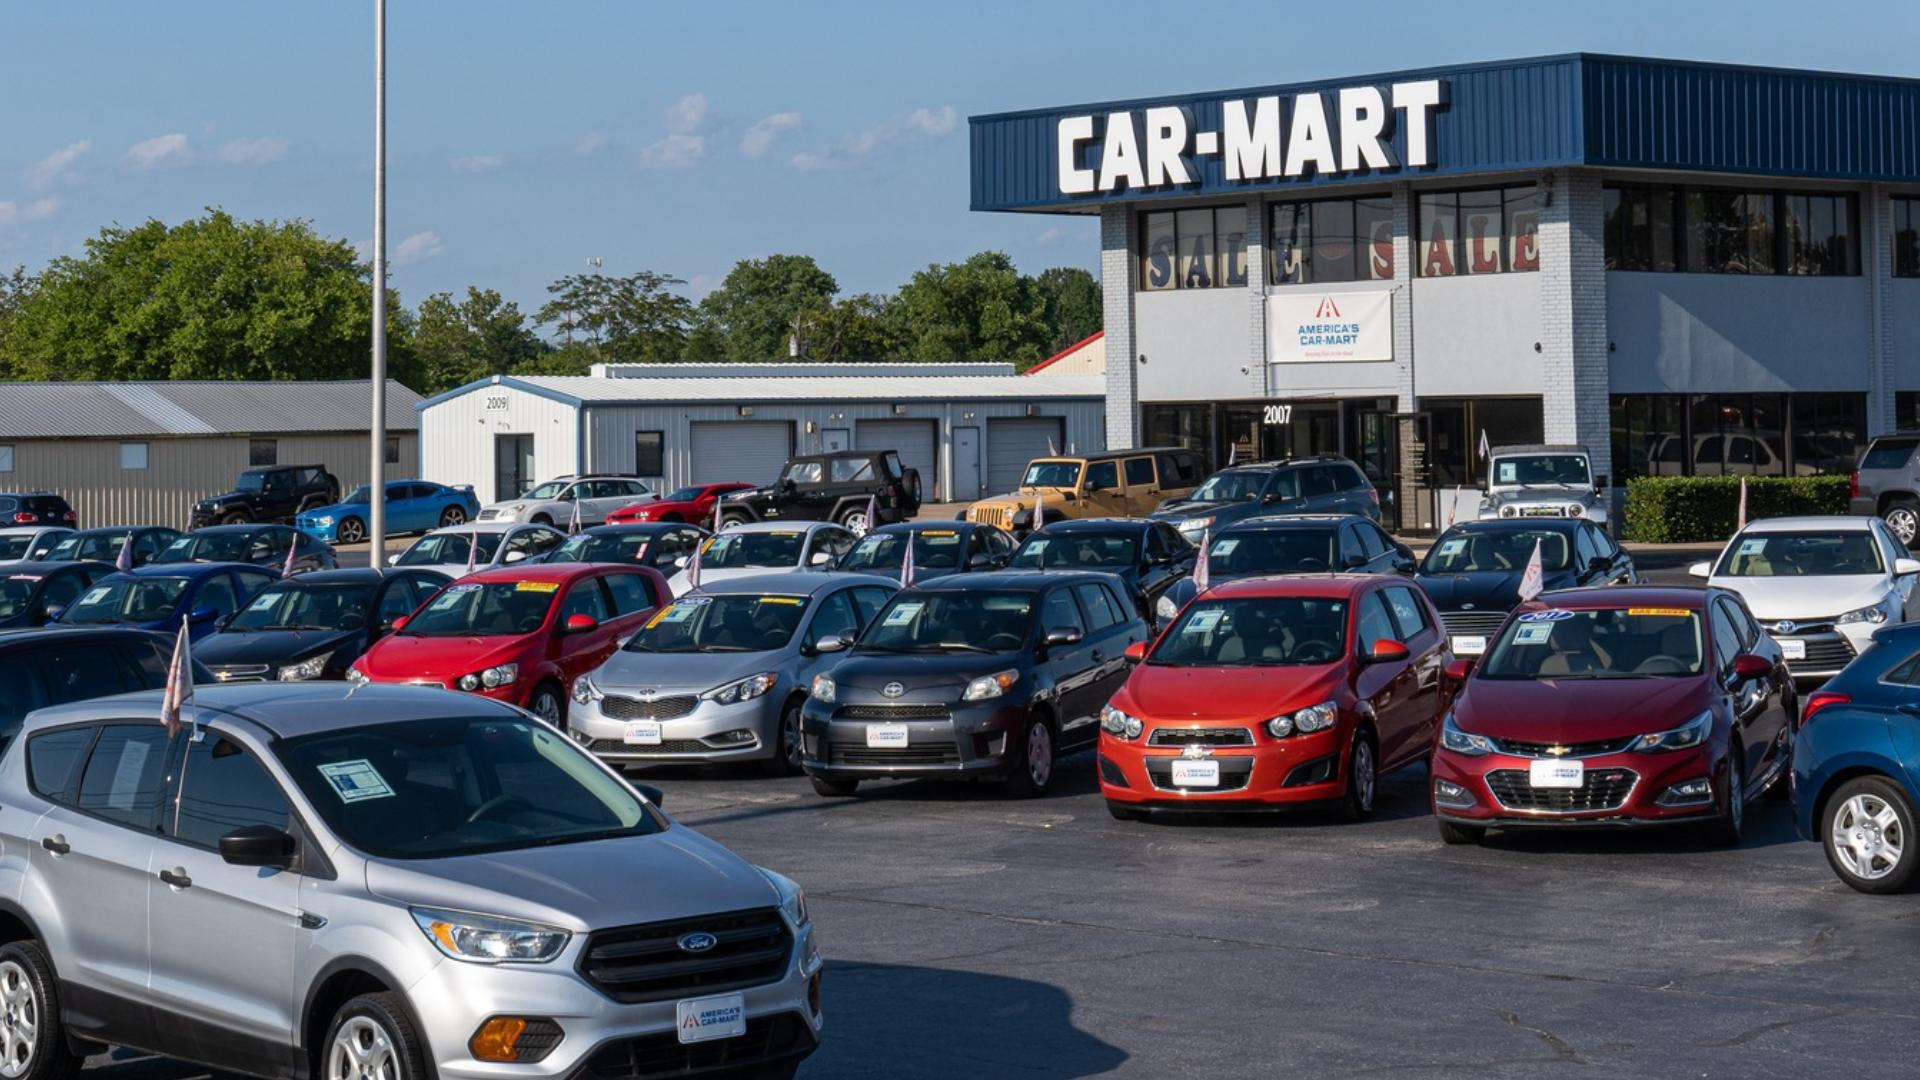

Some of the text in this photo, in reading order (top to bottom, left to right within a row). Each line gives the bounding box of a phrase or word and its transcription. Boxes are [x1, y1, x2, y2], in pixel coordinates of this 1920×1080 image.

[1058, 80, 1440, 194] CAR-MART
[1373, 213, 1540, 279] SALE
[1298, 323, 1360, 335] AMERICA'S
[1300, 334, 1359, 346] CAR-MART
[487, 396, 506, 410] 2009
[1263, 405, 1292, 424] 2007
[700, 1006, 741, 1019] AMERICA'S
[701, 1014, 740, 1026] CAR-MART
